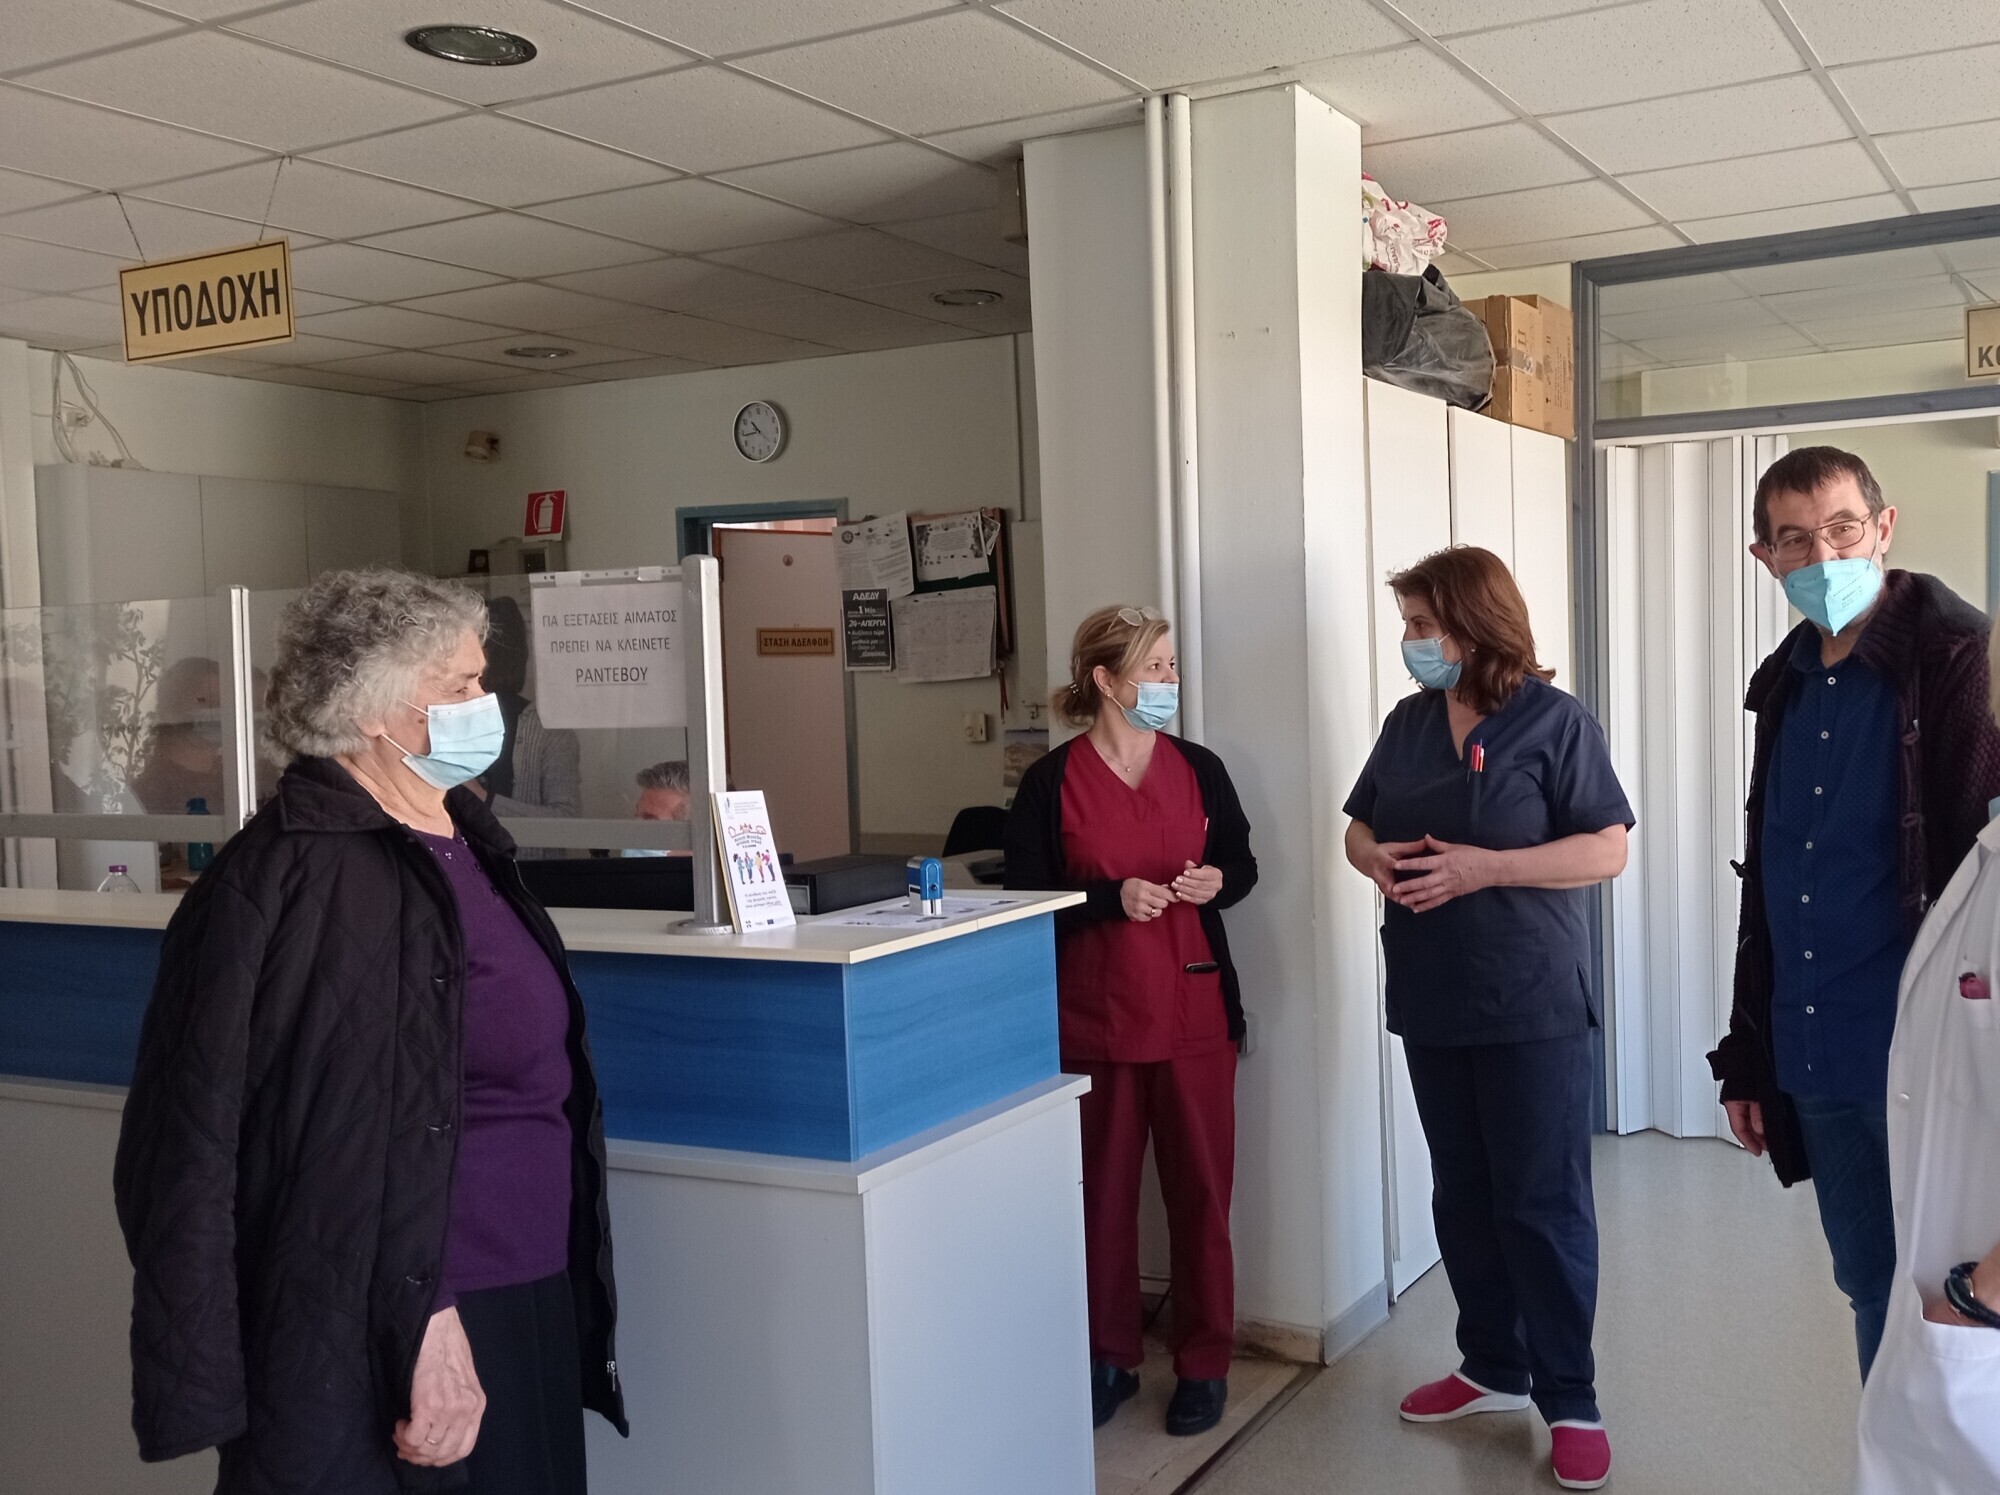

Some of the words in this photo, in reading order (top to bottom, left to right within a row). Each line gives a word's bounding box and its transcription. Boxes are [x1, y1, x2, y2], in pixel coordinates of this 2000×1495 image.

[130, 267, 281, 337] ΥΠΟΔΟΧΗ
[852, 591, 880, 601] ΑΔΕΔΥ
[542, 615, 559, 628] ΓΙΑ
[563, 612, 619, 627] ΕΞΕΤΑΣΕΙΣ
[624, 609, 678, 624] ΑΙΜΑΤΟΣ
[550, 640, 590, 653] ΠΡΕΠΕΙ
[596, 639, 612, 652] ΝΑ
[617, 637, 671, 651] ΚΛΕΙΝΕΤΕ
[763, 637, 789, 647] ΣΤΑΣΗ
[791, 637, 829, 647] ΑΔΕΛΦΩΝ
[575, 666, 649, 683] ΡΑΝΤΕΒΟΥ
